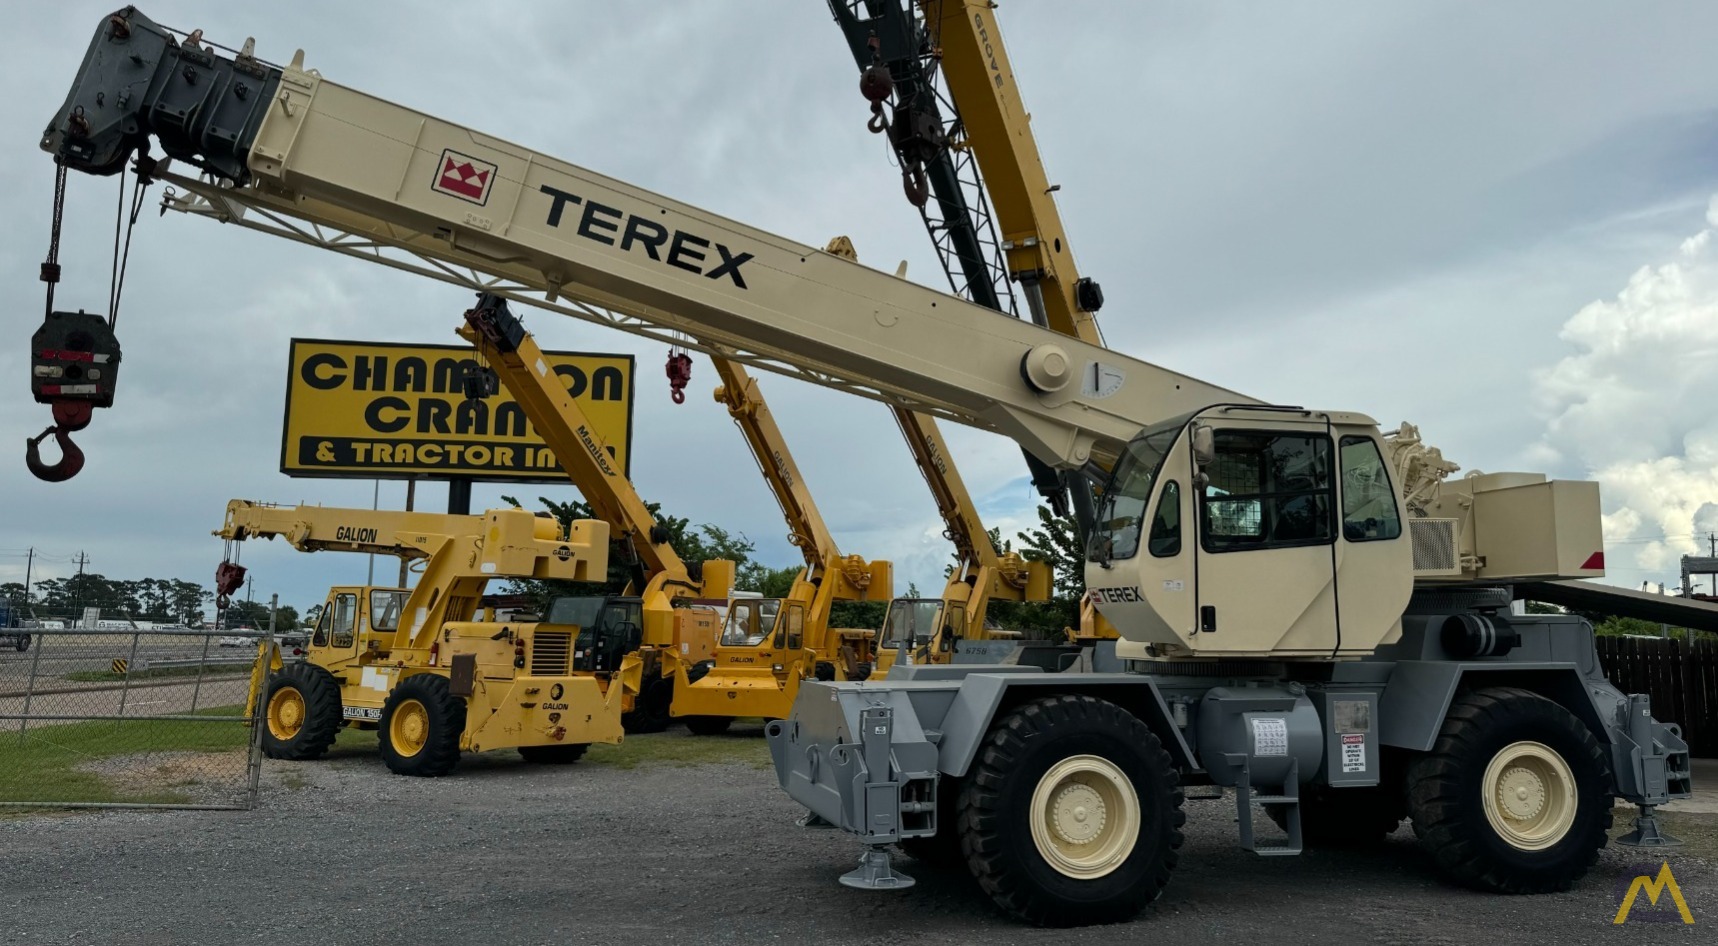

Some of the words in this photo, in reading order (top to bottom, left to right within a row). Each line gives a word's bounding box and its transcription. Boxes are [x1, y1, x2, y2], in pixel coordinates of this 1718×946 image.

[973, 13, 1004, 89] GROVE
[539, 184, 755, 290] TEREX
[300, 352, 624, 402] CHAMON
[364, 395, 541, 438] CRAN
[315, 440, 337, 463] &
[349, 441, 514, 468] TRACTOR
[524, 446, 563, 469] IN
[576, 424, 613, 474] Manitex
[773, 449, 795, 488] GALION
[926, 434, 948, 475] GALION
[336, 525, 378, 544] GALION
[552, 549, 576, 558] GALION
[1098, 586, 1145, 603] TEREX
[342, 707, 367, 718] GALION
[542, 702, 569, 711] GALION
